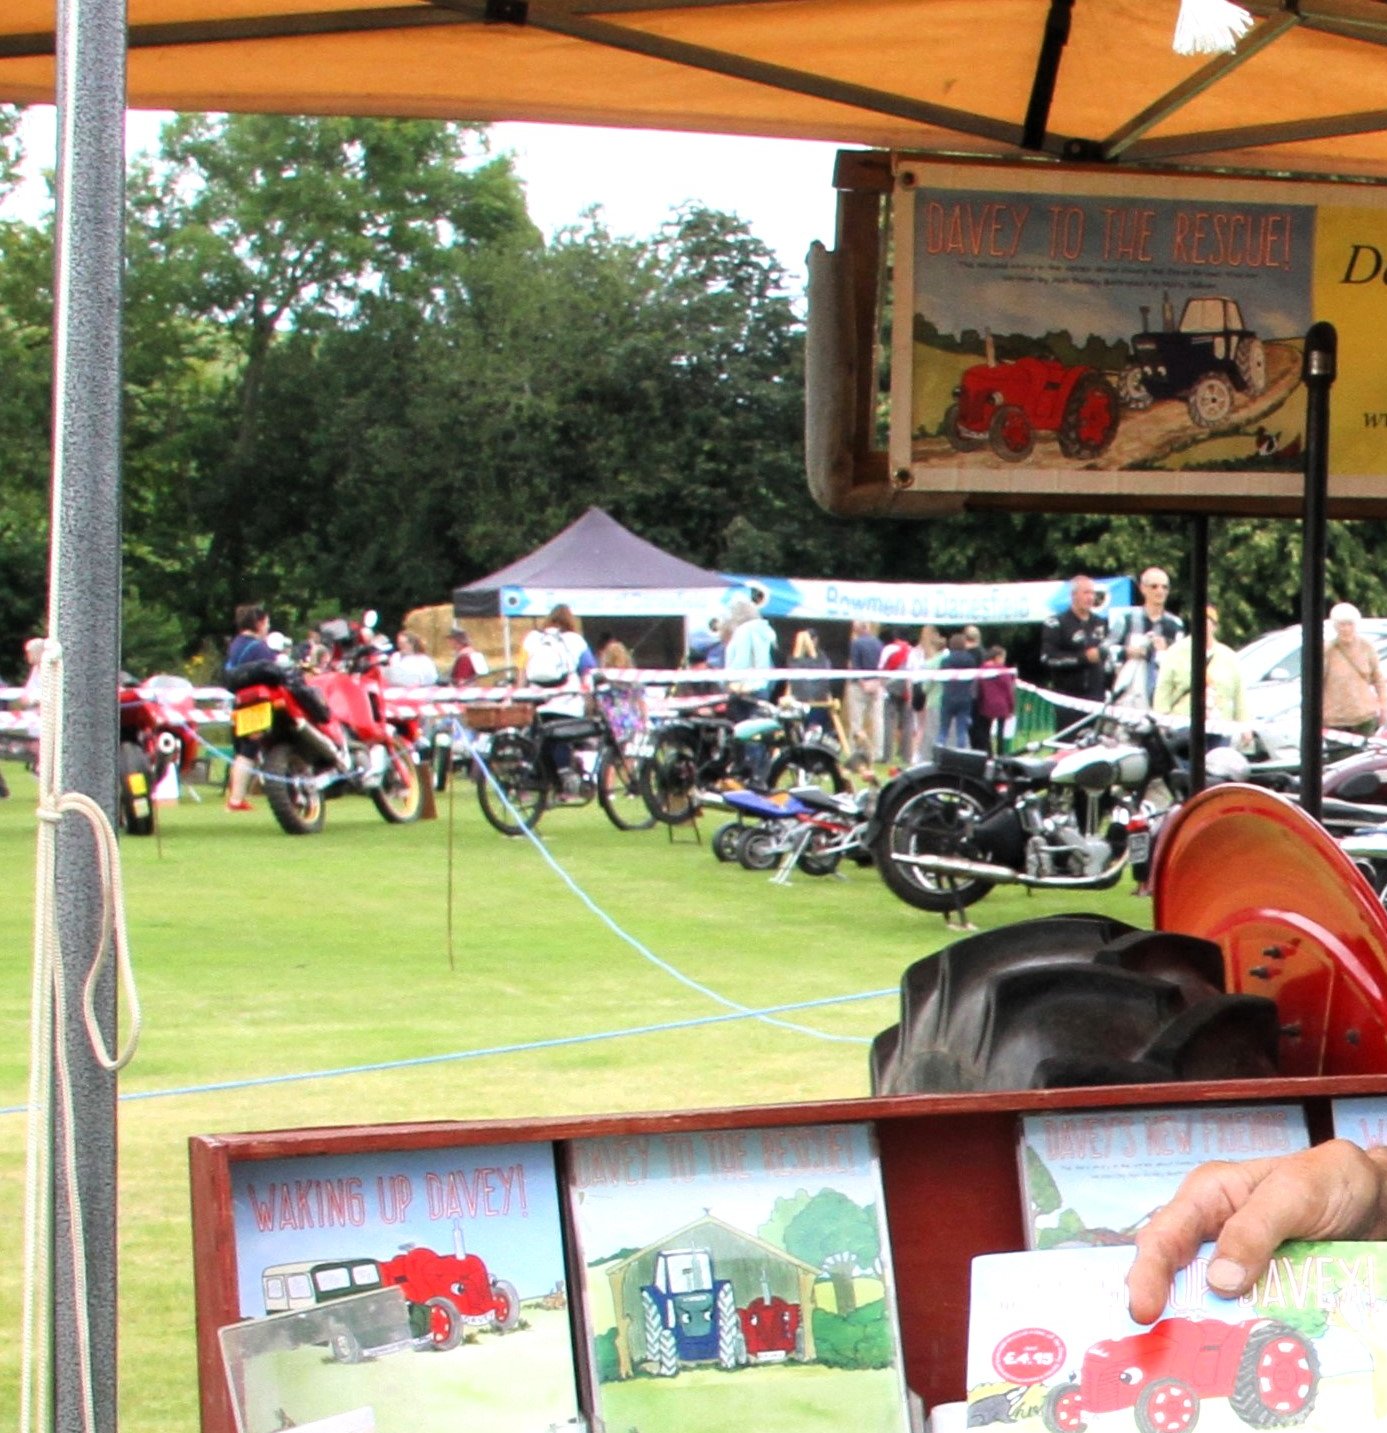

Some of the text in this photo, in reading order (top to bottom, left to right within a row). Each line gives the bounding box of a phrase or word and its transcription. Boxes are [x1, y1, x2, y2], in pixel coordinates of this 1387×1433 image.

[926, 202, 1294, 271] DAVEY TO THE RESCUE!
[246, 1163, 529, 1233] WAKING UP DAVEY!
[1236, 1255, 1378, 1310] AVEY!
